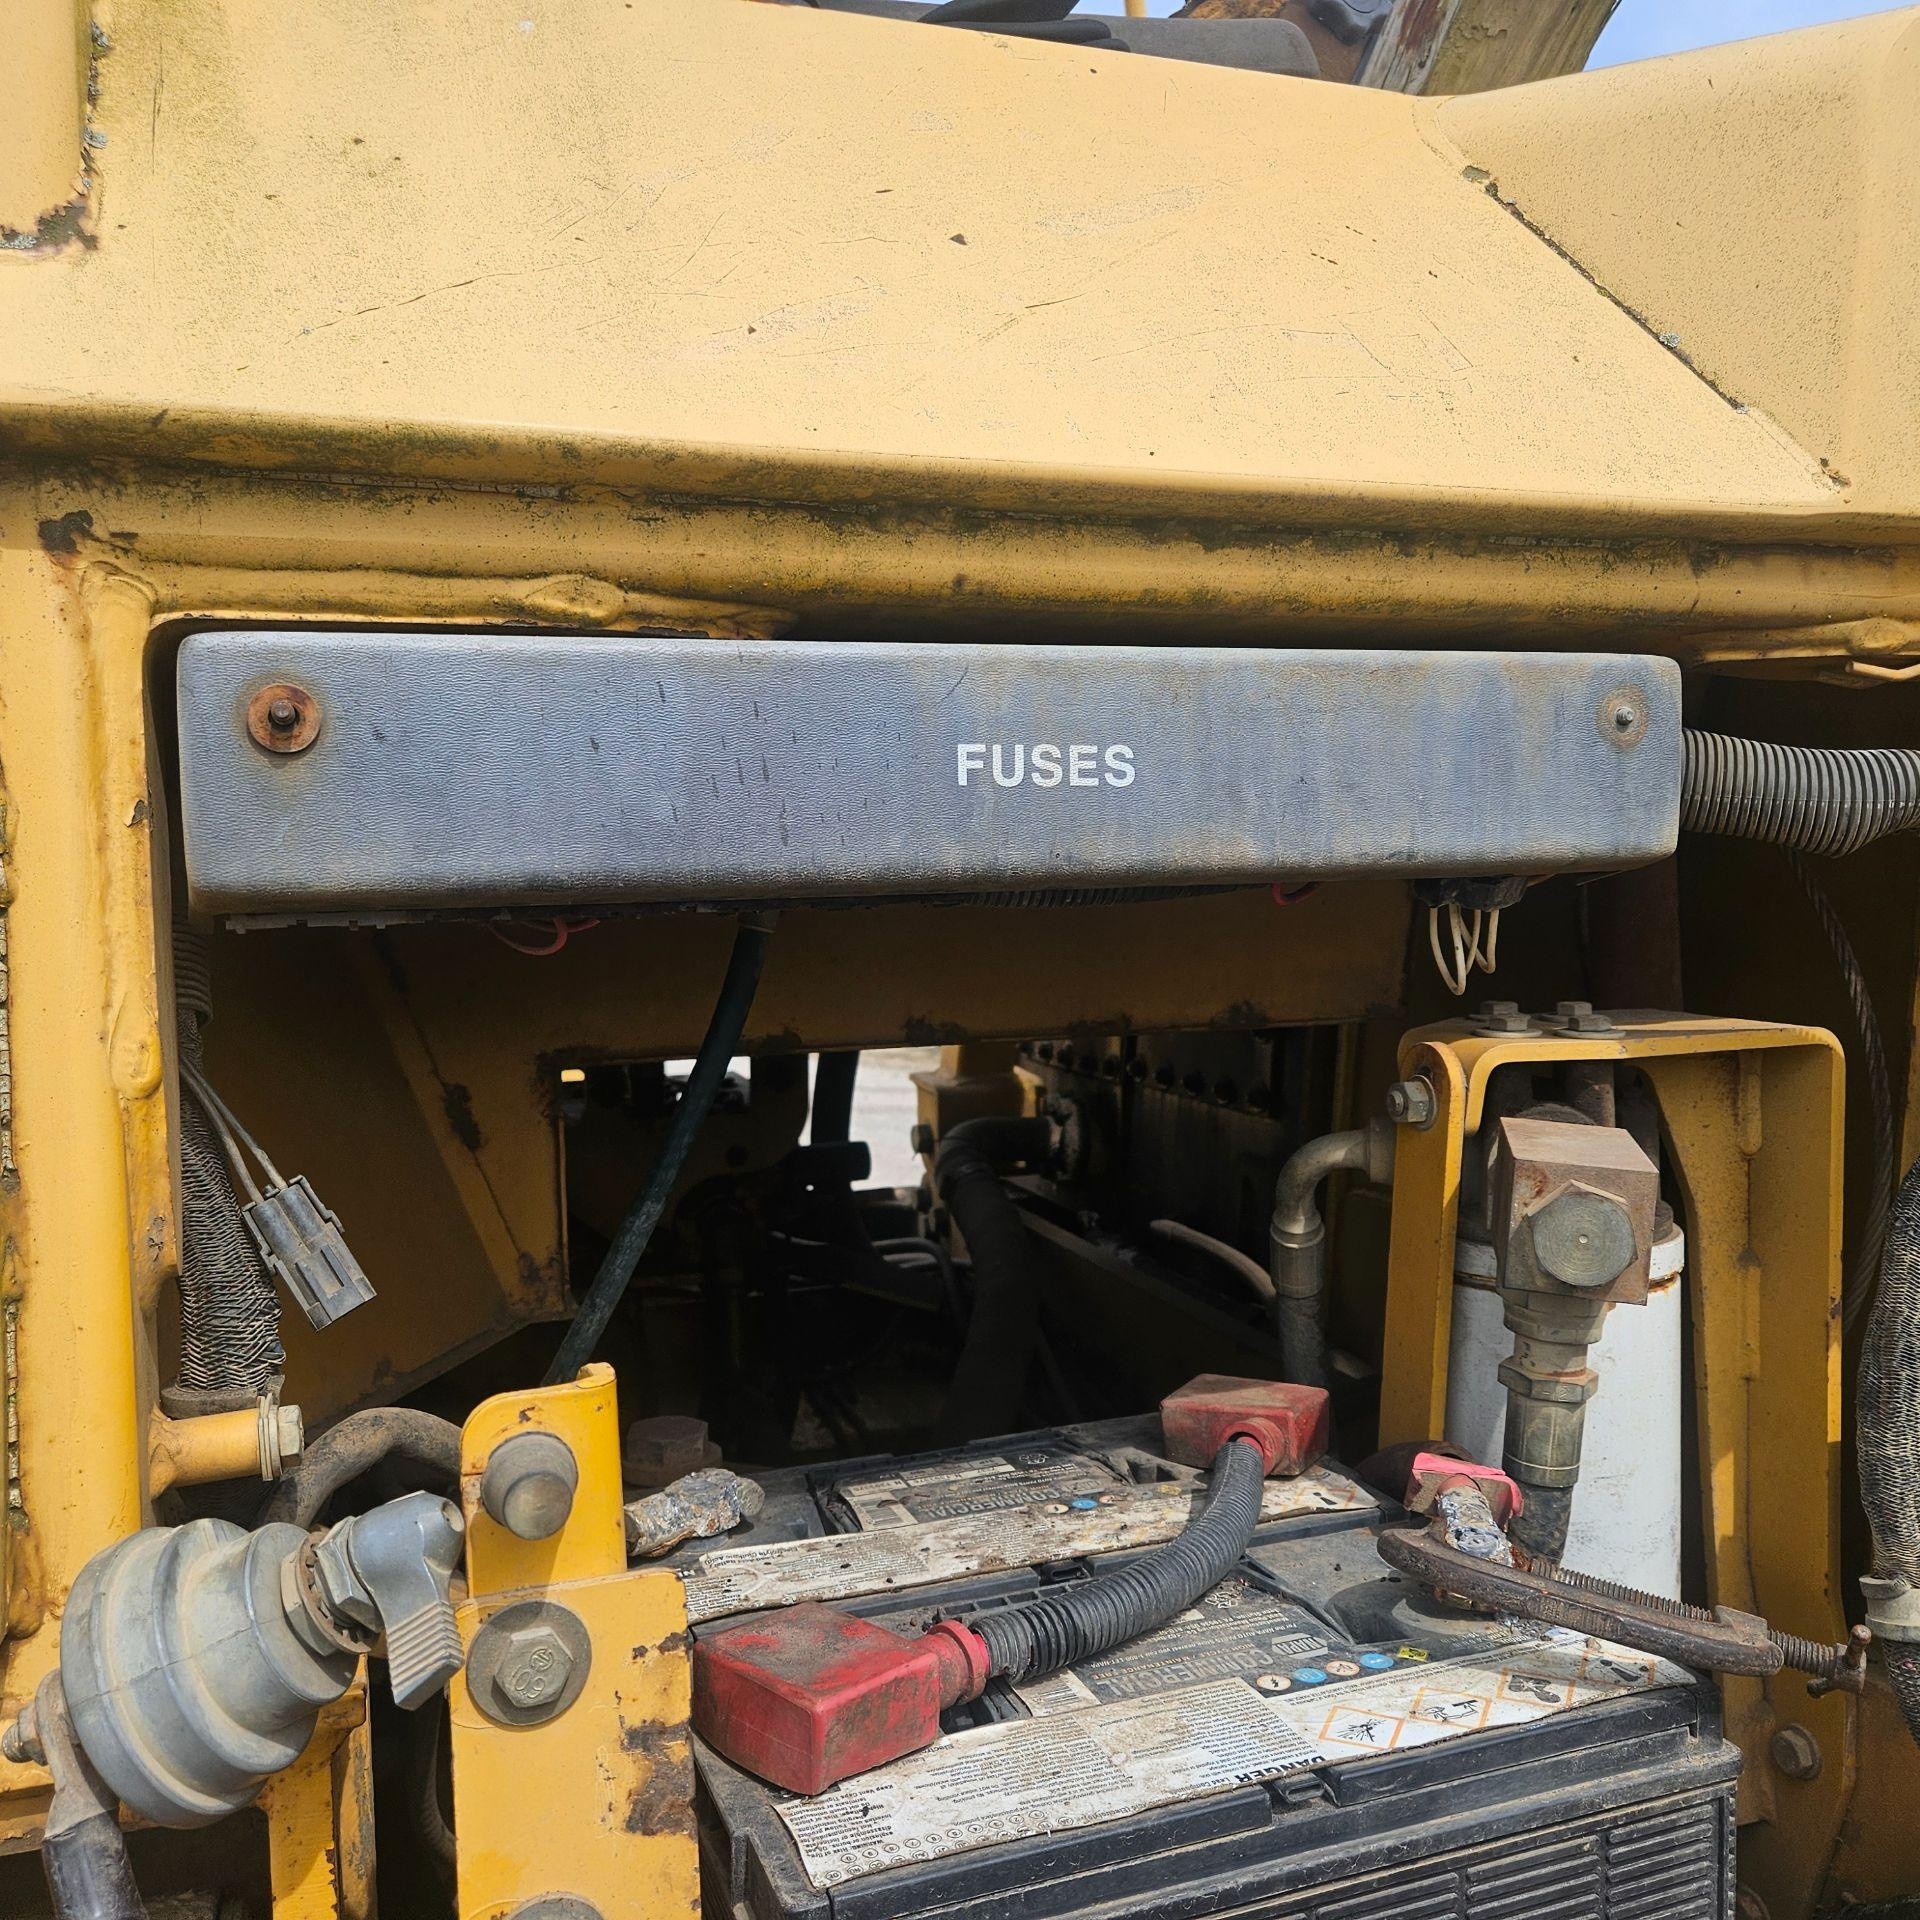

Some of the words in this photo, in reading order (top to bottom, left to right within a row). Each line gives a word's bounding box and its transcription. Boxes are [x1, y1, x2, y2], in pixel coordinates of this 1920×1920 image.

[957, 743, 1136, 787] FUSES
[919, 1488, 1062, 1519] COMMERCIAL
[1228, 1641, 1255, 1652] HIGH
[1277, 1636, 1322, 1655] NAPA
[1095, 1649, 1274, 1697] COMMERCIAL
[1121, 1654, 1190, 1674] MAINTENANCE
[1234, 1754, 1325, 1784] DANGER
[874, 1783, 893, 1791] Keep
[1210, 1776, 1230, 1785] Lead
[839, 1791, 857, 1799] Caps
